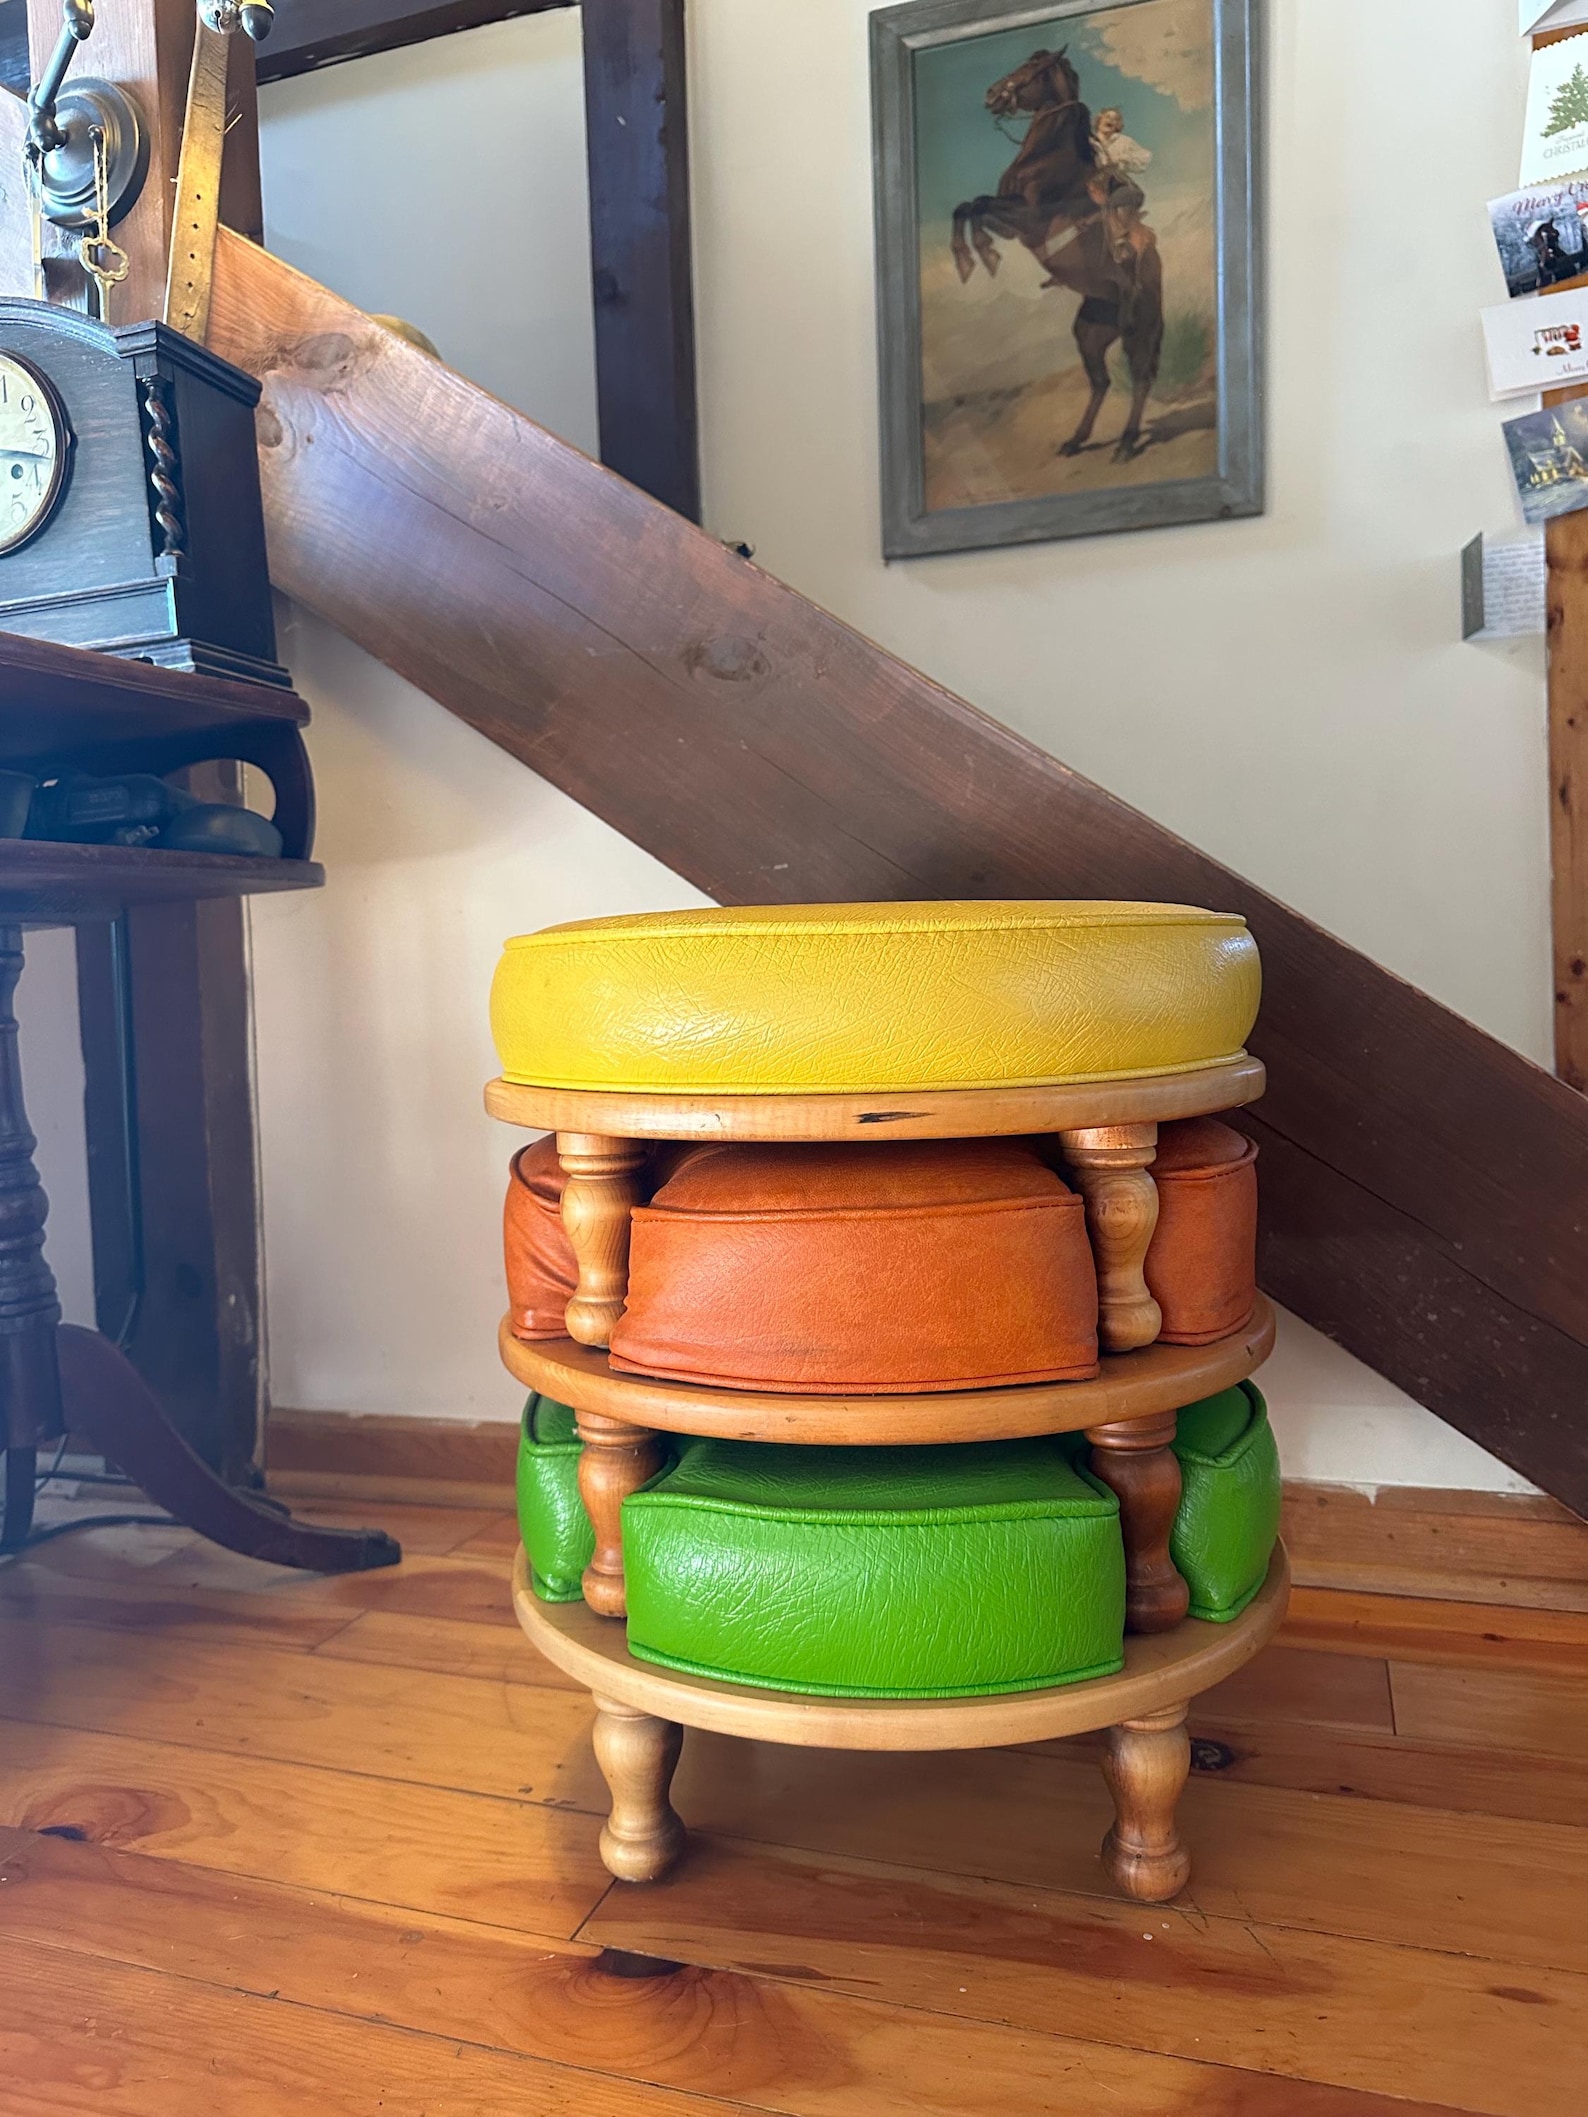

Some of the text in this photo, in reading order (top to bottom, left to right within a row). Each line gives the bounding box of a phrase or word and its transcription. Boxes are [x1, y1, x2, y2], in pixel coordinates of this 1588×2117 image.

[20, 394, 37, 424] 2
[32, 428, 50, 457] 3
[11, 492, 28, 525] 5
